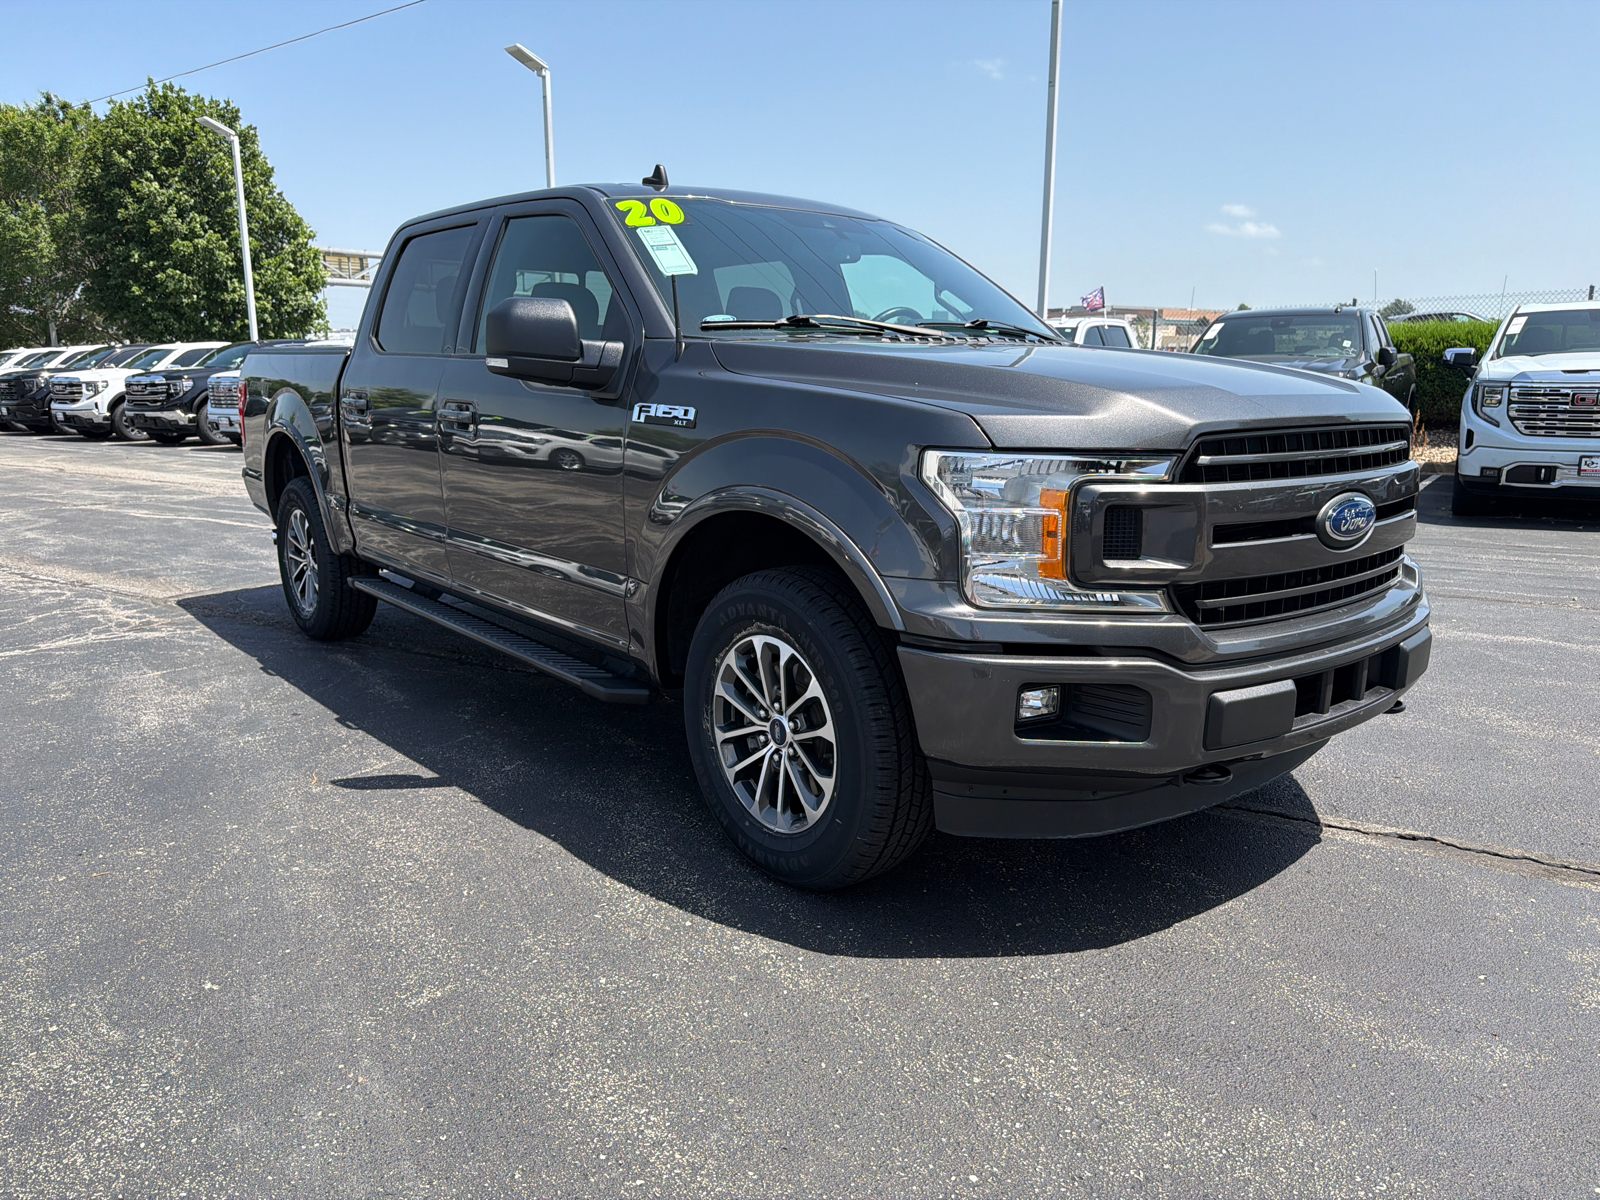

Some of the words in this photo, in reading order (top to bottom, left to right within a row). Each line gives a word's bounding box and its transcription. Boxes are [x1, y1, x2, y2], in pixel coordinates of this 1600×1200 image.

[615, 198, 685, 227] 20
[1341, 508, 1370, 532] Ford
[720, 602, 788, 629] ADVANTA
